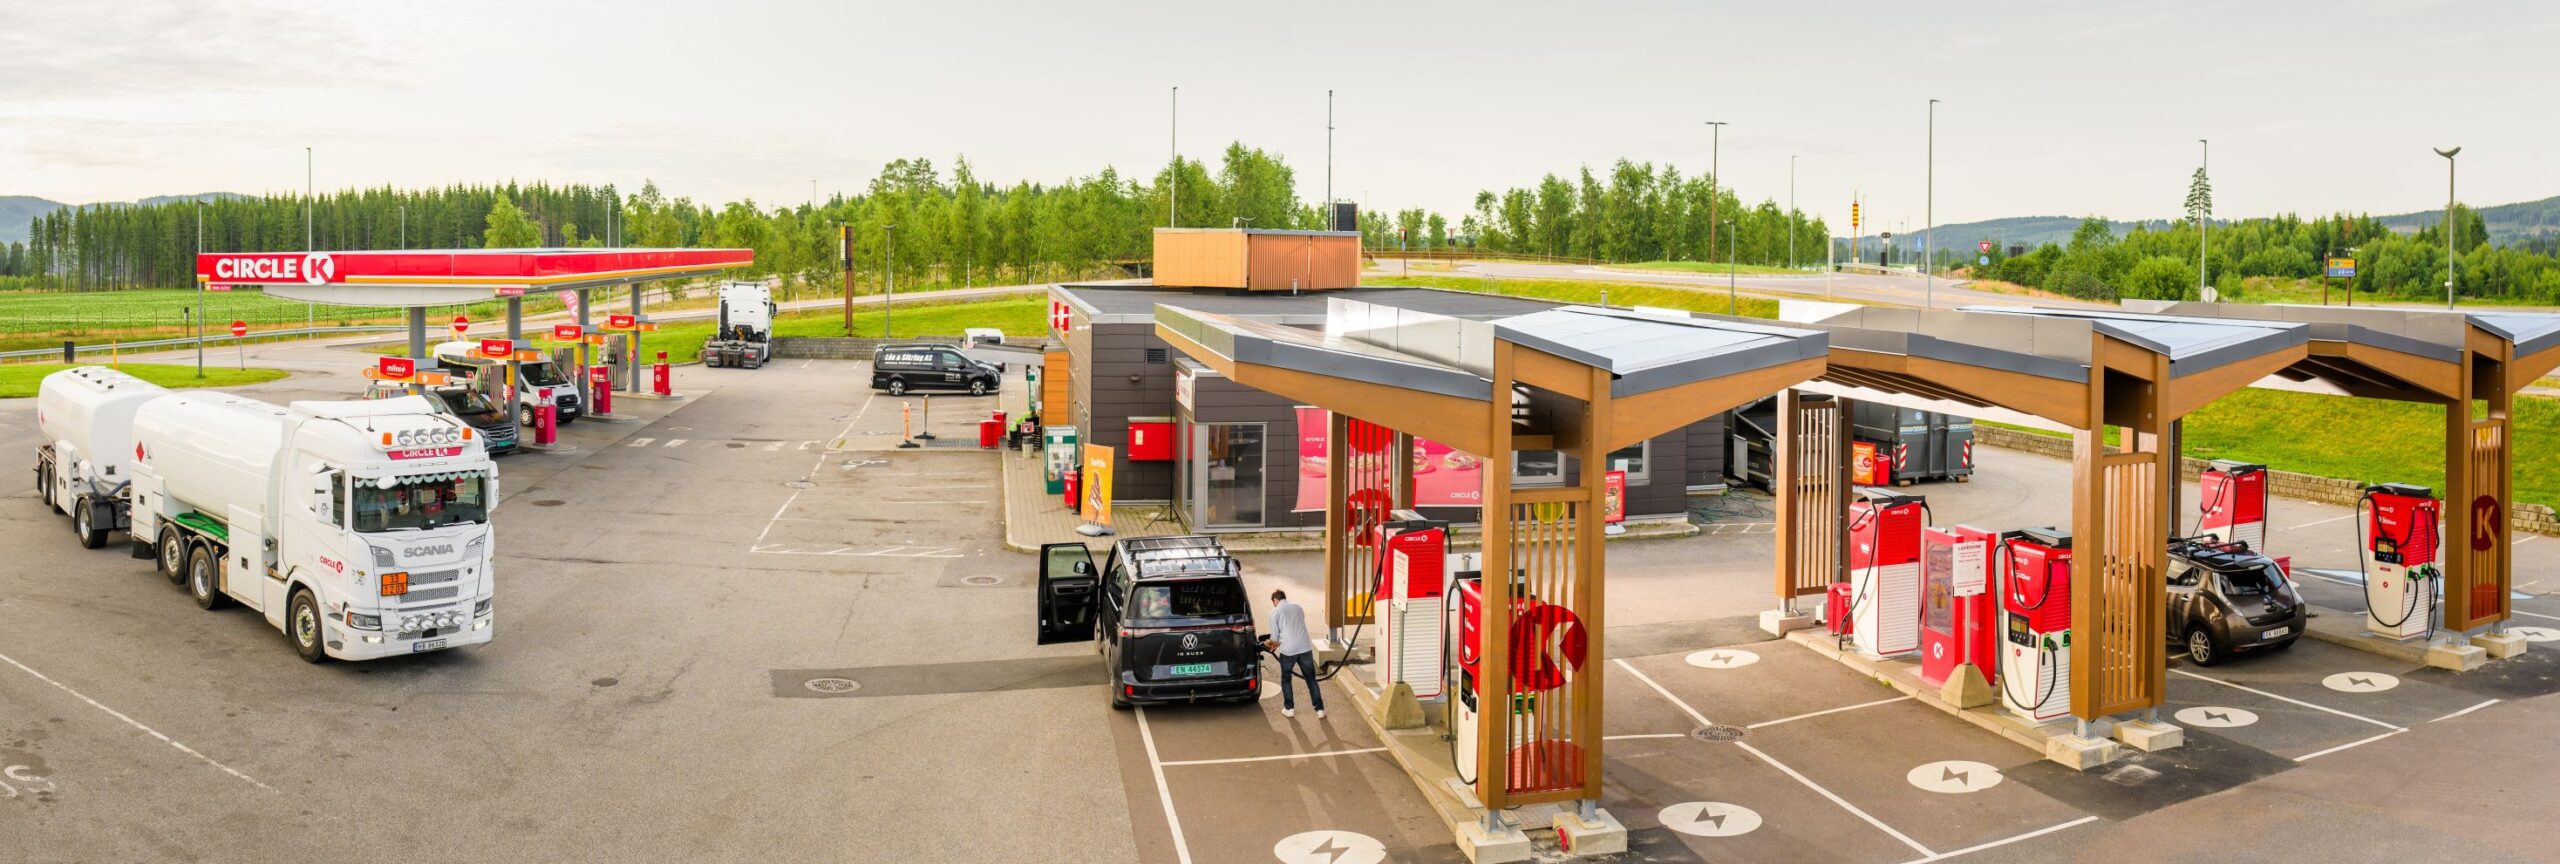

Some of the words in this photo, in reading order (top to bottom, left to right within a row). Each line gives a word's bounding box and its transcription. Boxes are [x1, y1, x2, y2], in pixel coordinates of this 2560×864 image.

[216, 258, 297, 278] CIRCLE
[306, 255, 334, 284] K
[923, 353, 933, 361] AS
[403, 448, 434, 457] CIRCLE
[436, 448, 448, 456] K
[2474, 500, 2498, 549] K
[404, 544, 454, 558] SCANIA
[320, 555, 336, 569] CIRCLE
[336, 561, 343, 574] K
[390, 575, 399, 584] 33
[384, 584, 405, 594] 1203
[1933, 641, 1943, 660] K
[1176, 664, 1186, 674] EN
[1188, 664, 1210, 673] 44574
